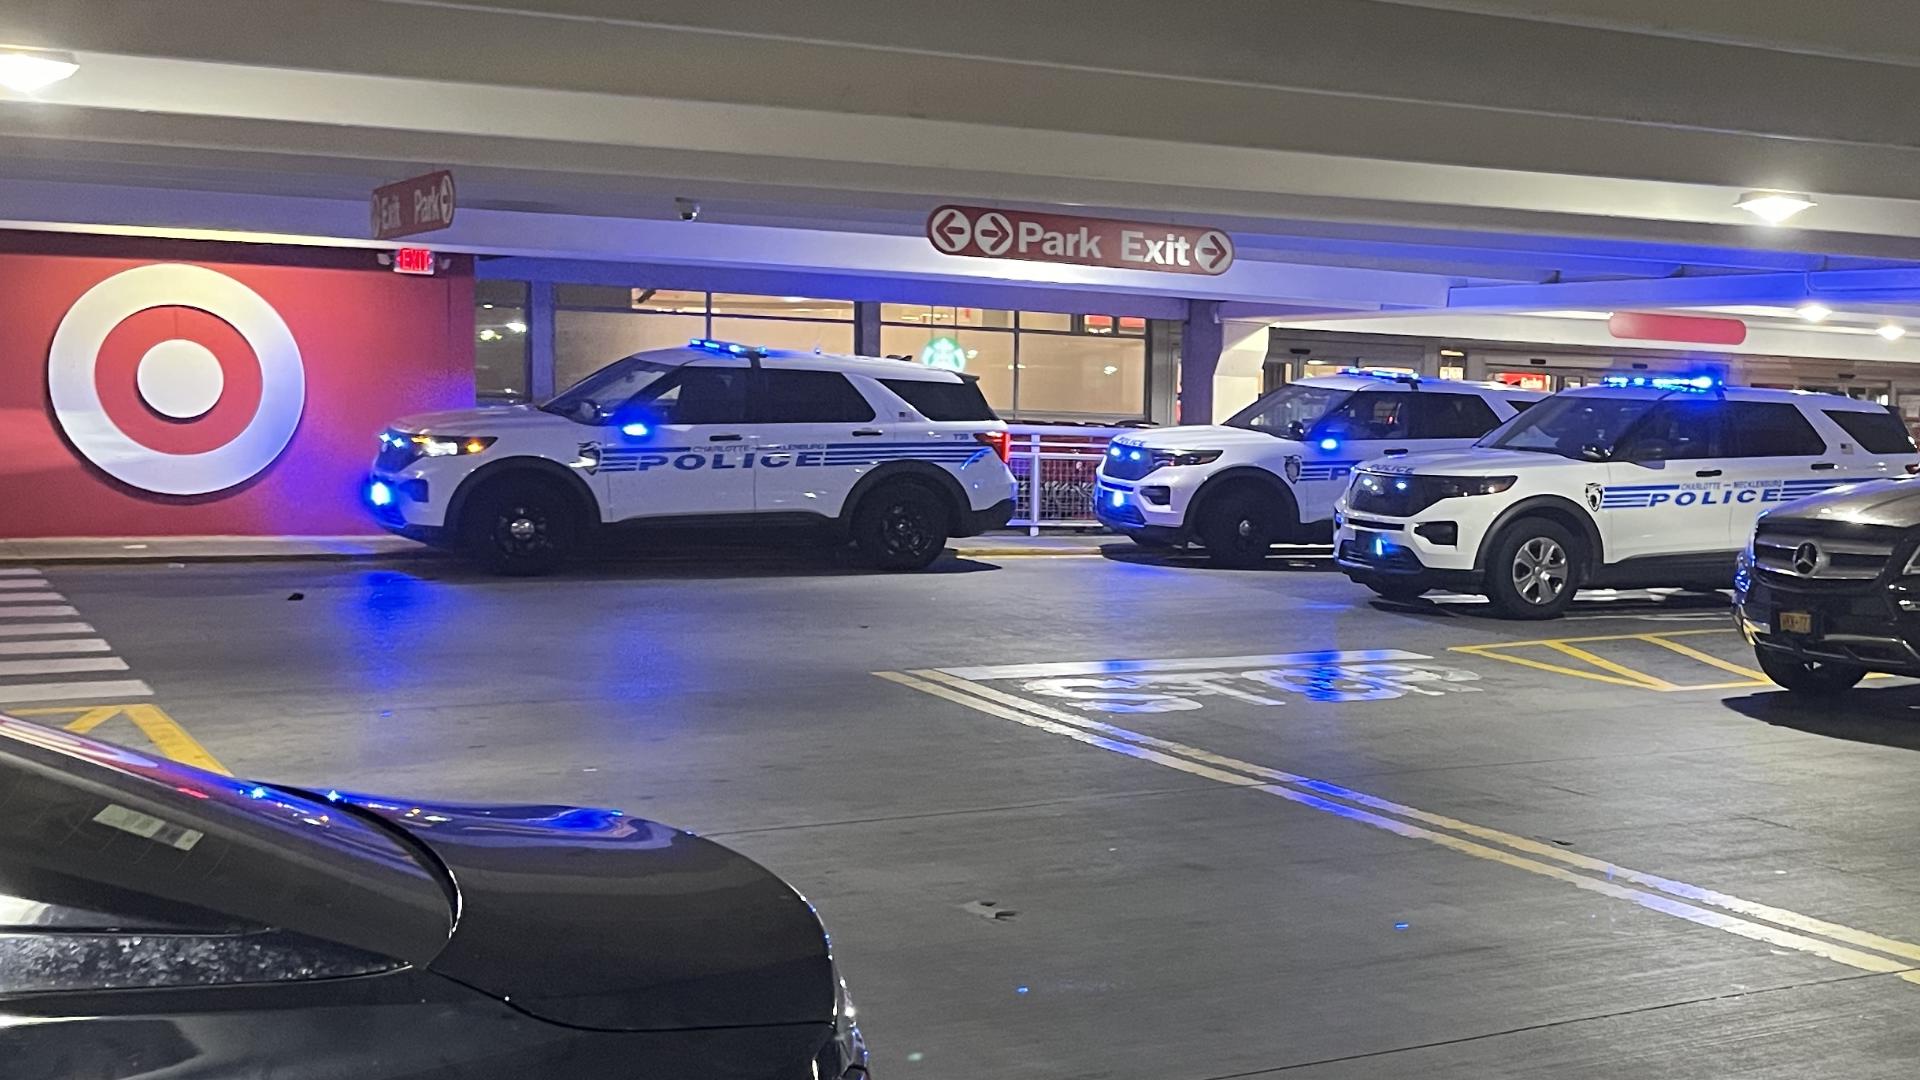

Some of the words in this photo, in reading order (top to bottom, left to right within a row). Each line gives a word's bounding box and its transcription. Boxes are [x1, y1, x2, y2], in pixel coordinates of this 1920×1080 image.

[381, 193, 400, 231] Exit
[414, 186, 441, 225] Park
[1018, 221, 1101, 259] Park
[1121, 229, 1190, 266] Exit
[402, 249, 430, 271] EXIT
[639, 451, 819, 471] POLICE
[1370, 462, 1416, 475] POLICE
[1681, 482, 1721, 491] CHARLOTTE
[1649, 488, 1782, 507] POLICE
[1022, 664, 1484, 713] STOP
